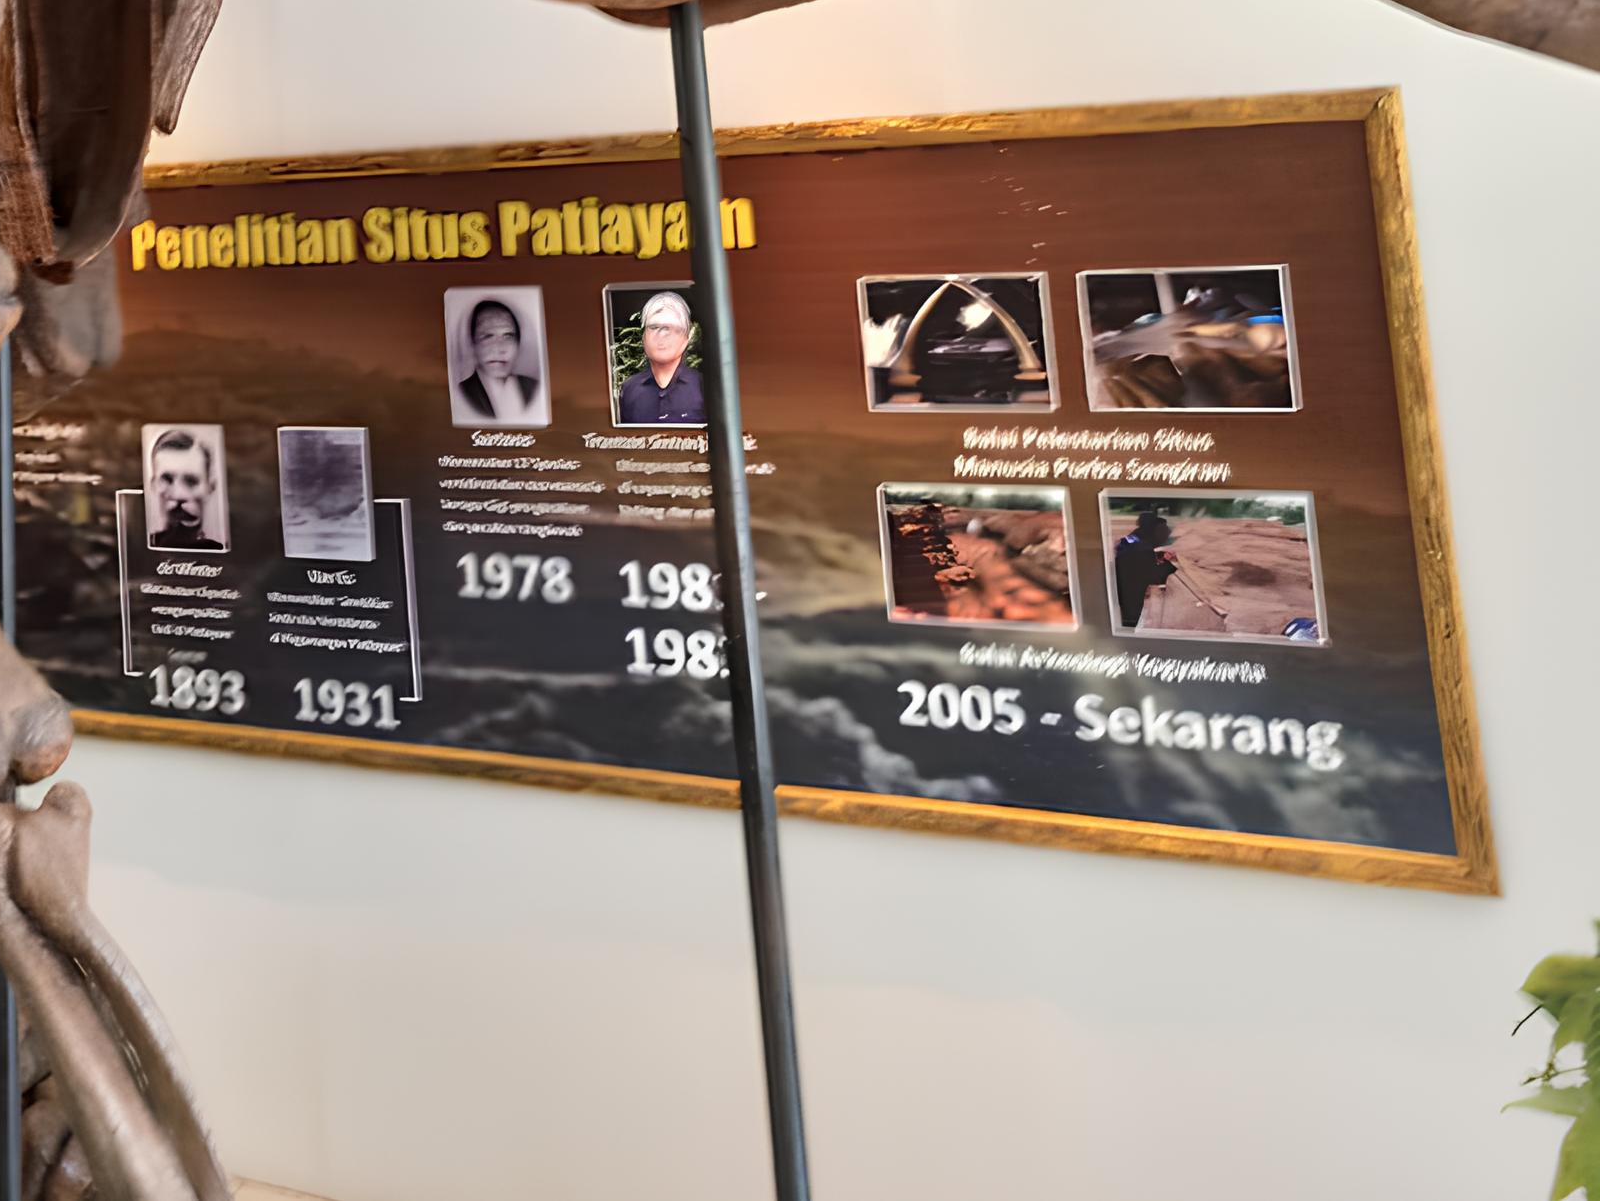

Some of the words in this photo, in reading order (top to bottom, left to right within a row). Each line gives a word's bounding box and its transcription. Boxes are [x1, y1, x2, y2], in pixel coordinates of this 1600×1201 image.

[132, 212, 357, 271] Penelitian
[362, 207, 491, 262] Situs
[456, 552, 575, 604] 1978
[618, 560, 723, 612] 198
[625, 626, 730, 679] 198
[149, 664, 247, 715] 1893
[294, 678, 401, 731] 1931
[897, 680, 1026, 735] 2005
[1074, 694, 1345, 771] Sekarang
